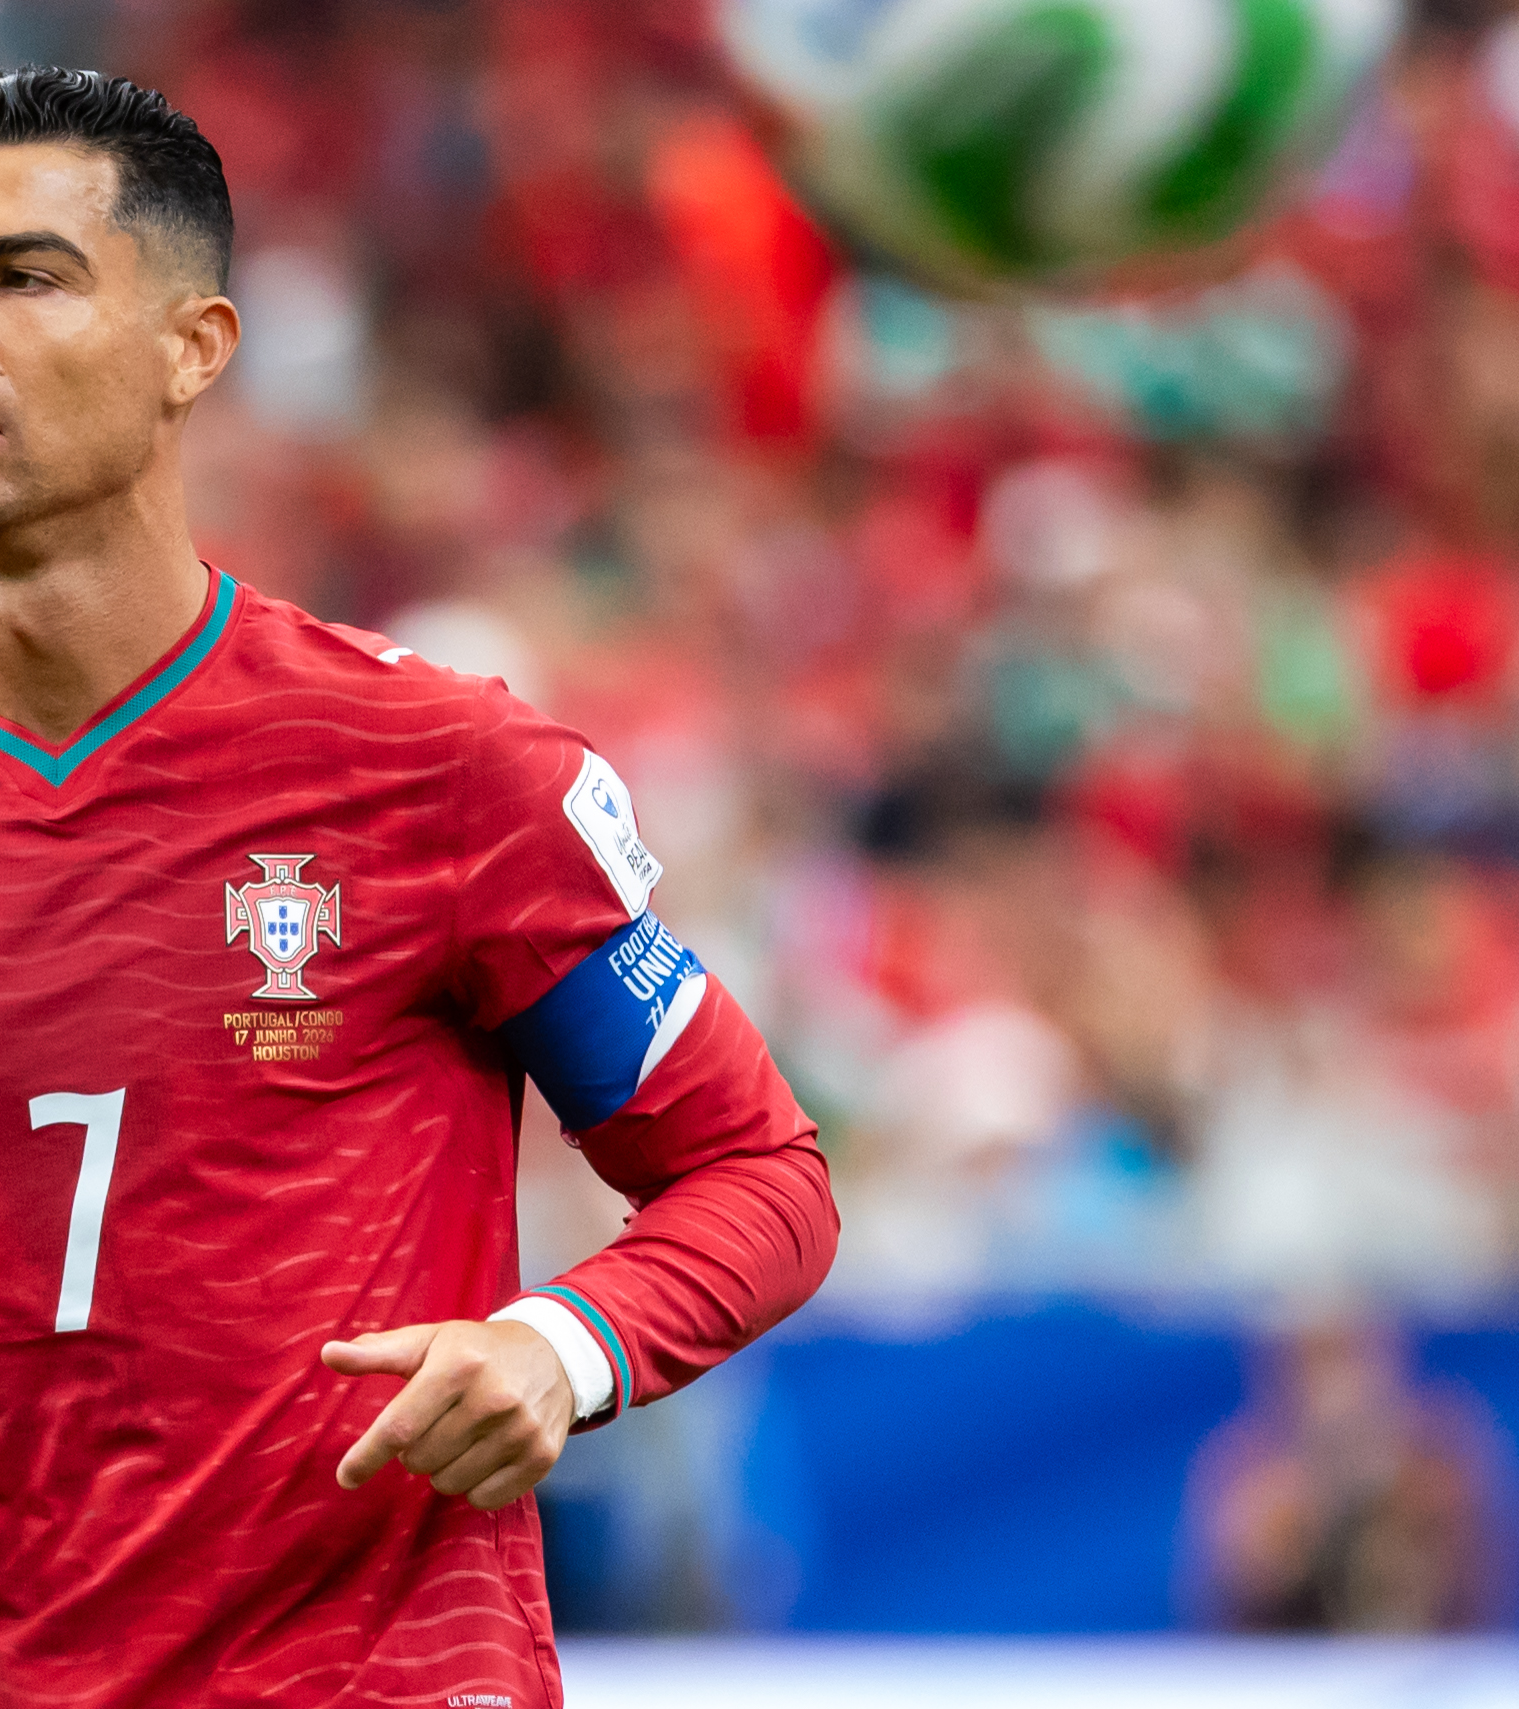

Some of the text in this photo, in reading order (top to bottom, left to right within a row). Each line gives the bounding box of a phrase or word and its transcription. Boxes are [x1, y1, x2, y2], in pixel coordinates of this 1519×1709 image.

[224, 1011, 344, 1029] PORTUGAL/CONGO
[235, 1029, 334, 1046] 17 JUNHO 2026
[253, 1046, 319, 1061] HOUSTON
[28, 1087, 126, 1333] 7
